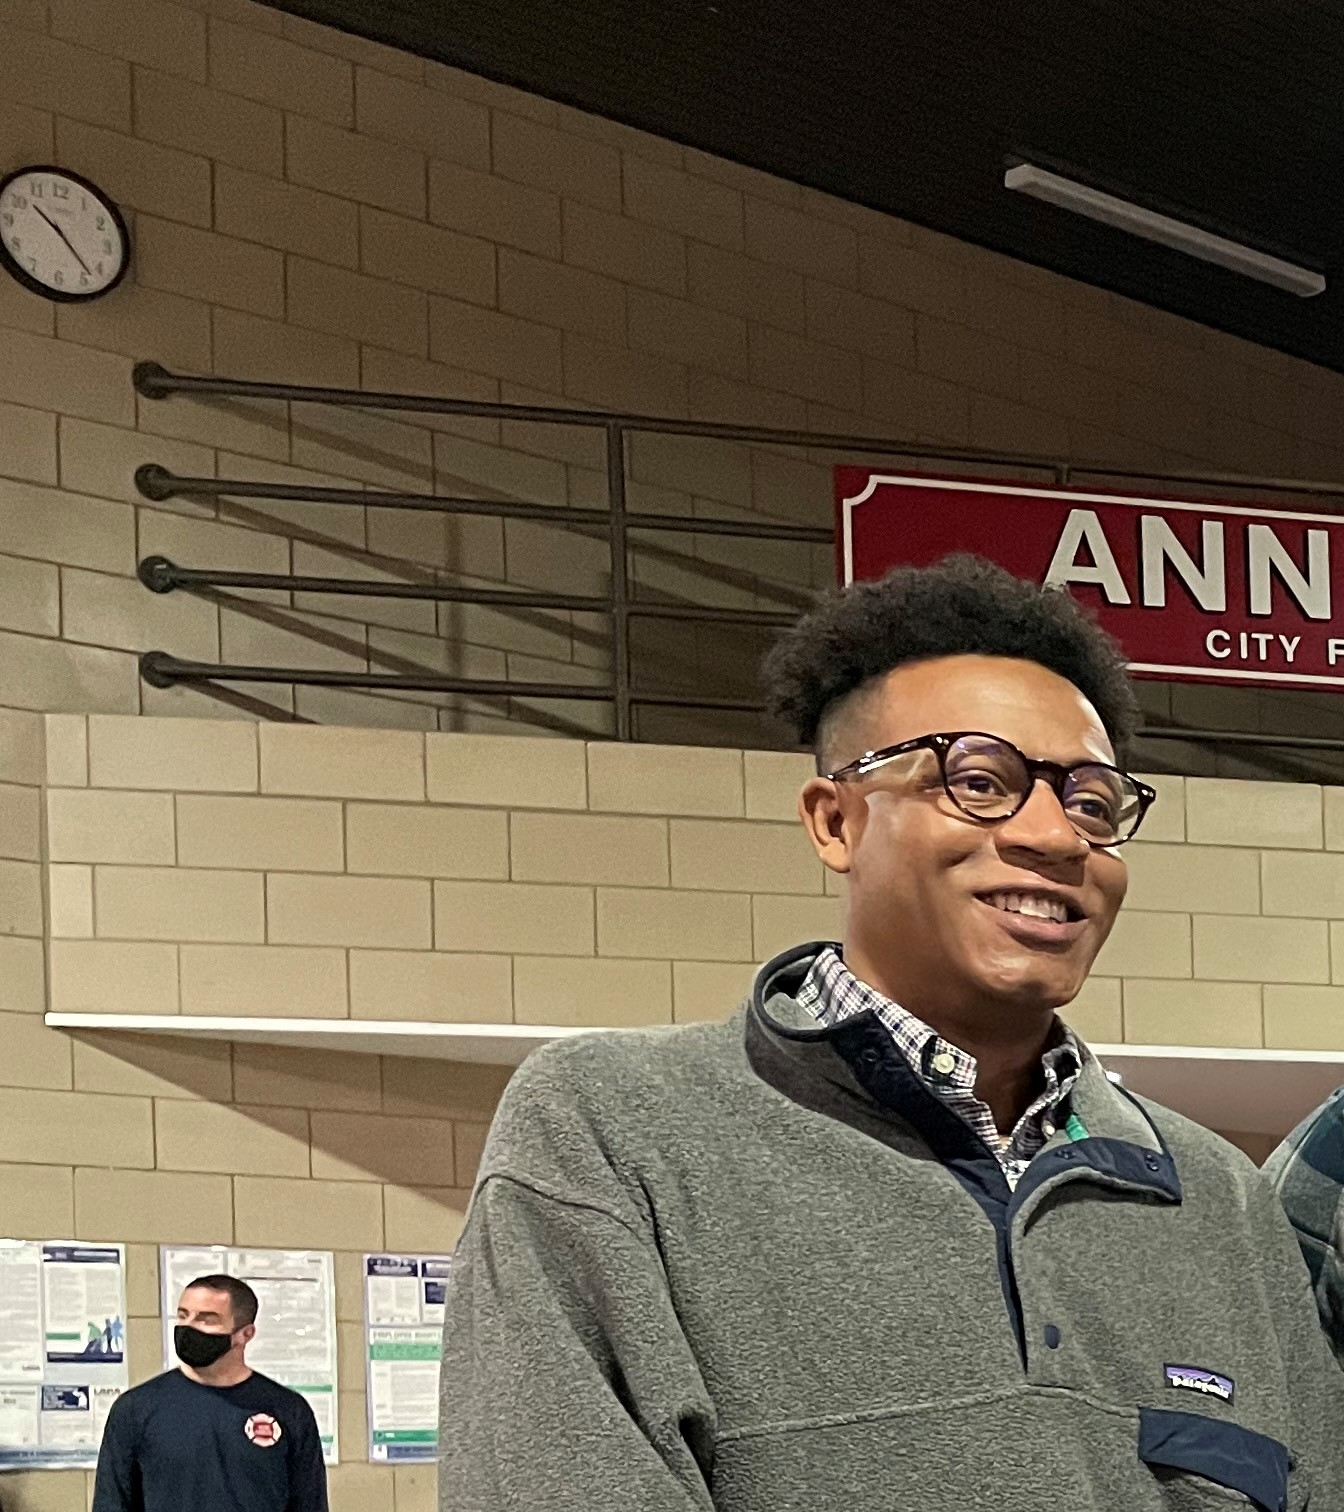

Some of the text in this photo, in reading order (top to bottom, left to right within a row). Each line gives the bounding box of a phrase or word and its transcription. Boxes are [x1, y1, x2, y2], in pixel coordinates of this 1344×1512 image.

[53, 182, 69, 200] 12
[95, 216, 106, 232] 2
[1041, 508, 1331, 619] ANN
[1205, 629, 1301, 662] CITY
